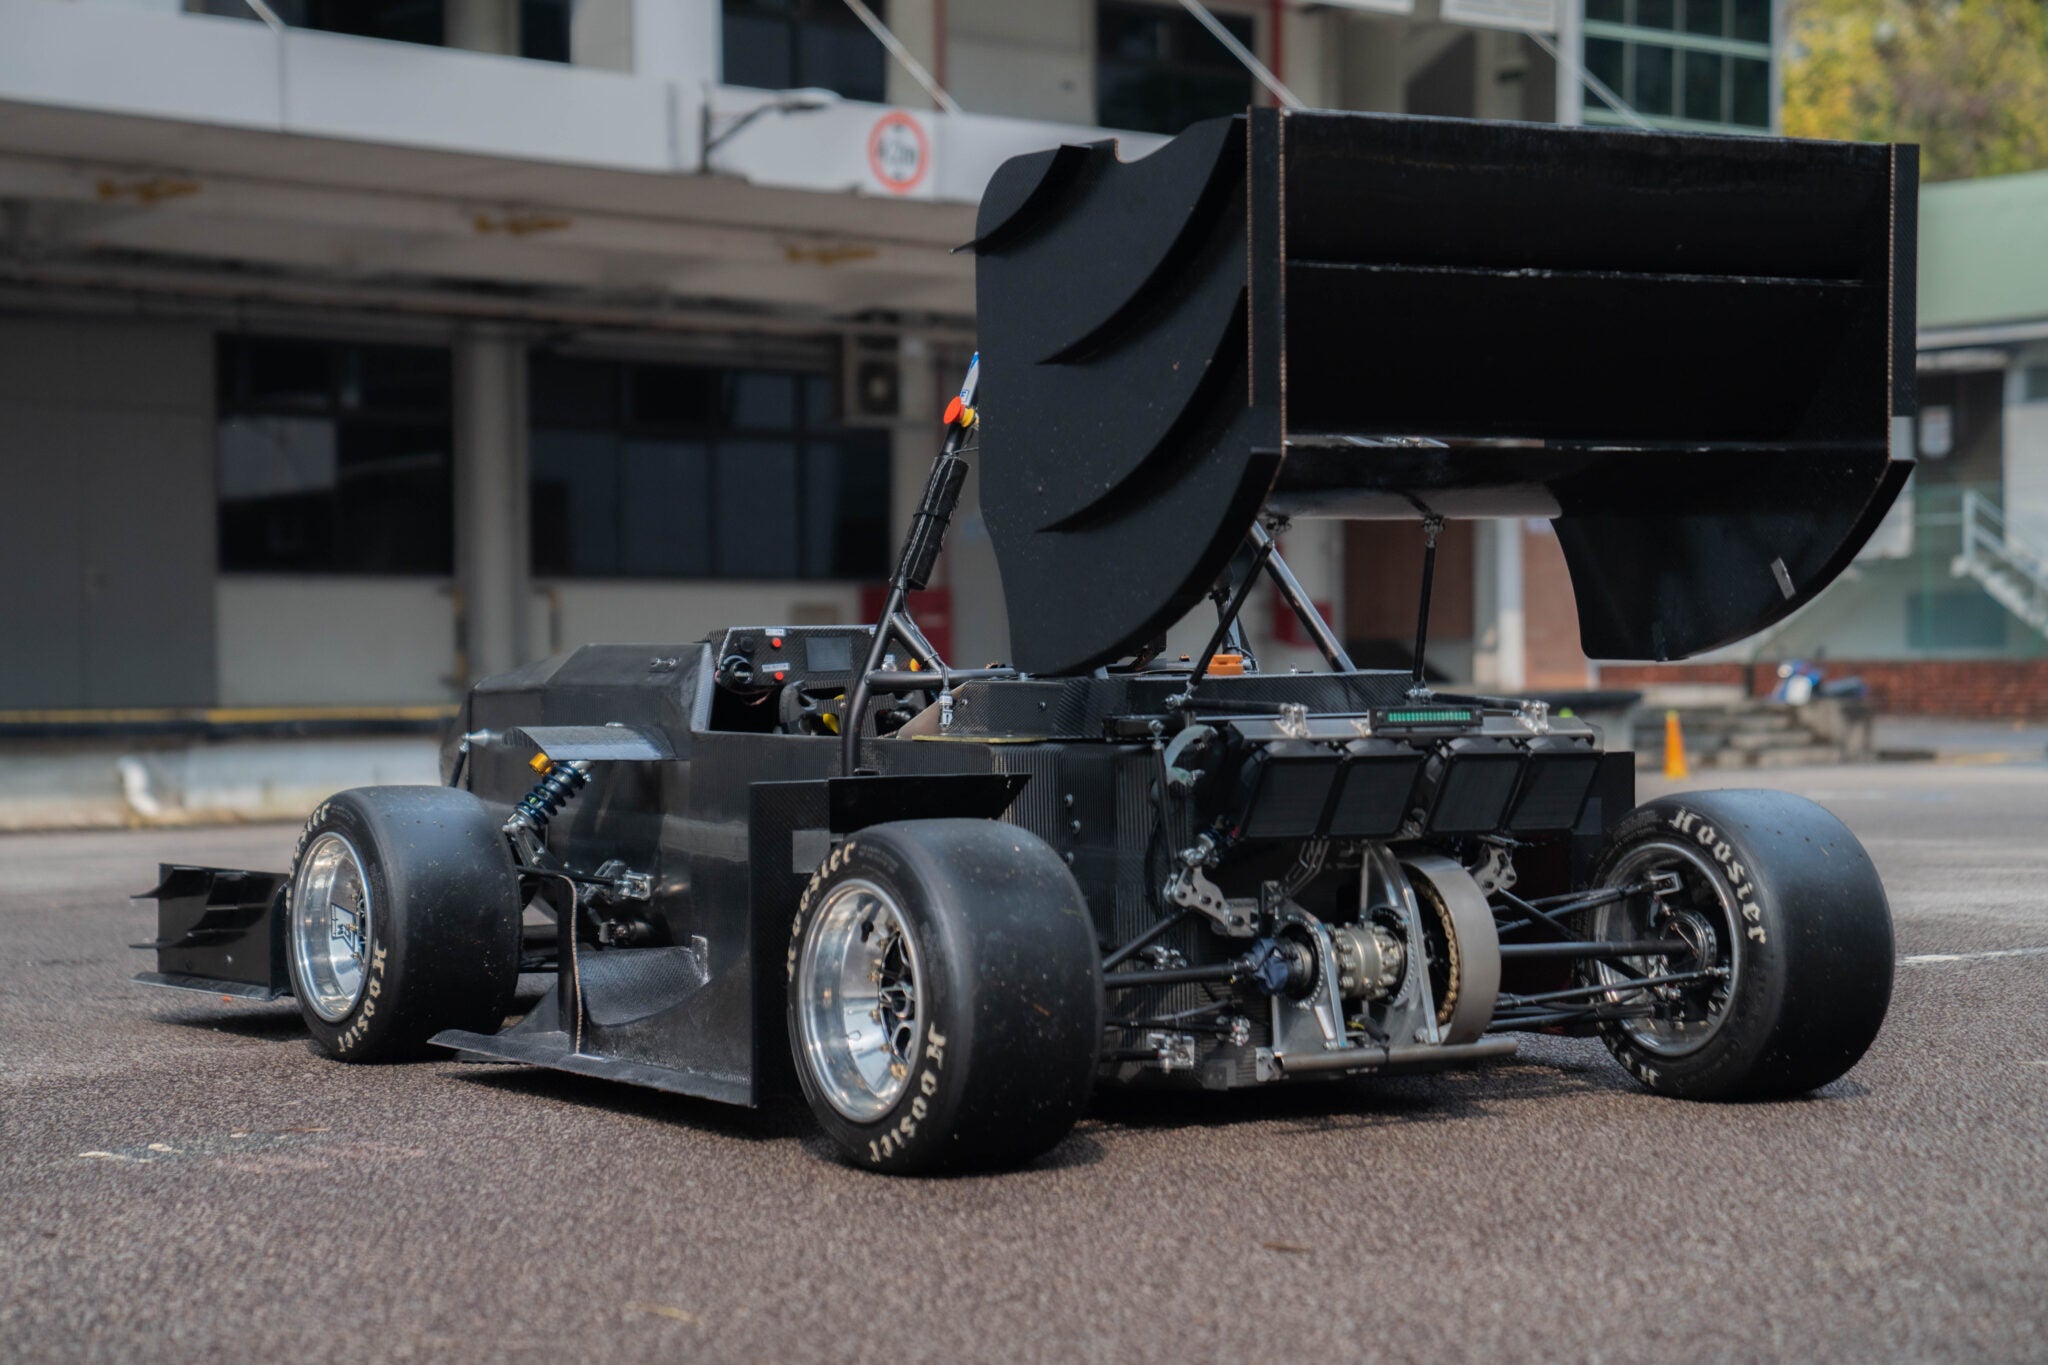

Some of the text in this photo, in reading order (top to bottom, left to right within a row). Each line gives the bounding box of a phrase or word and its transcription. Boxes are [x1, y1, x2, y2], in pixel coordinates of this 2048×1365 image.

[787, 841, 856, 982] Hoosier
[1669, 806, 1766, 944] Hoosier
[337, 939, 387, 1053] Hoosier
[869, 1021, 947, 1163] Hoosier
